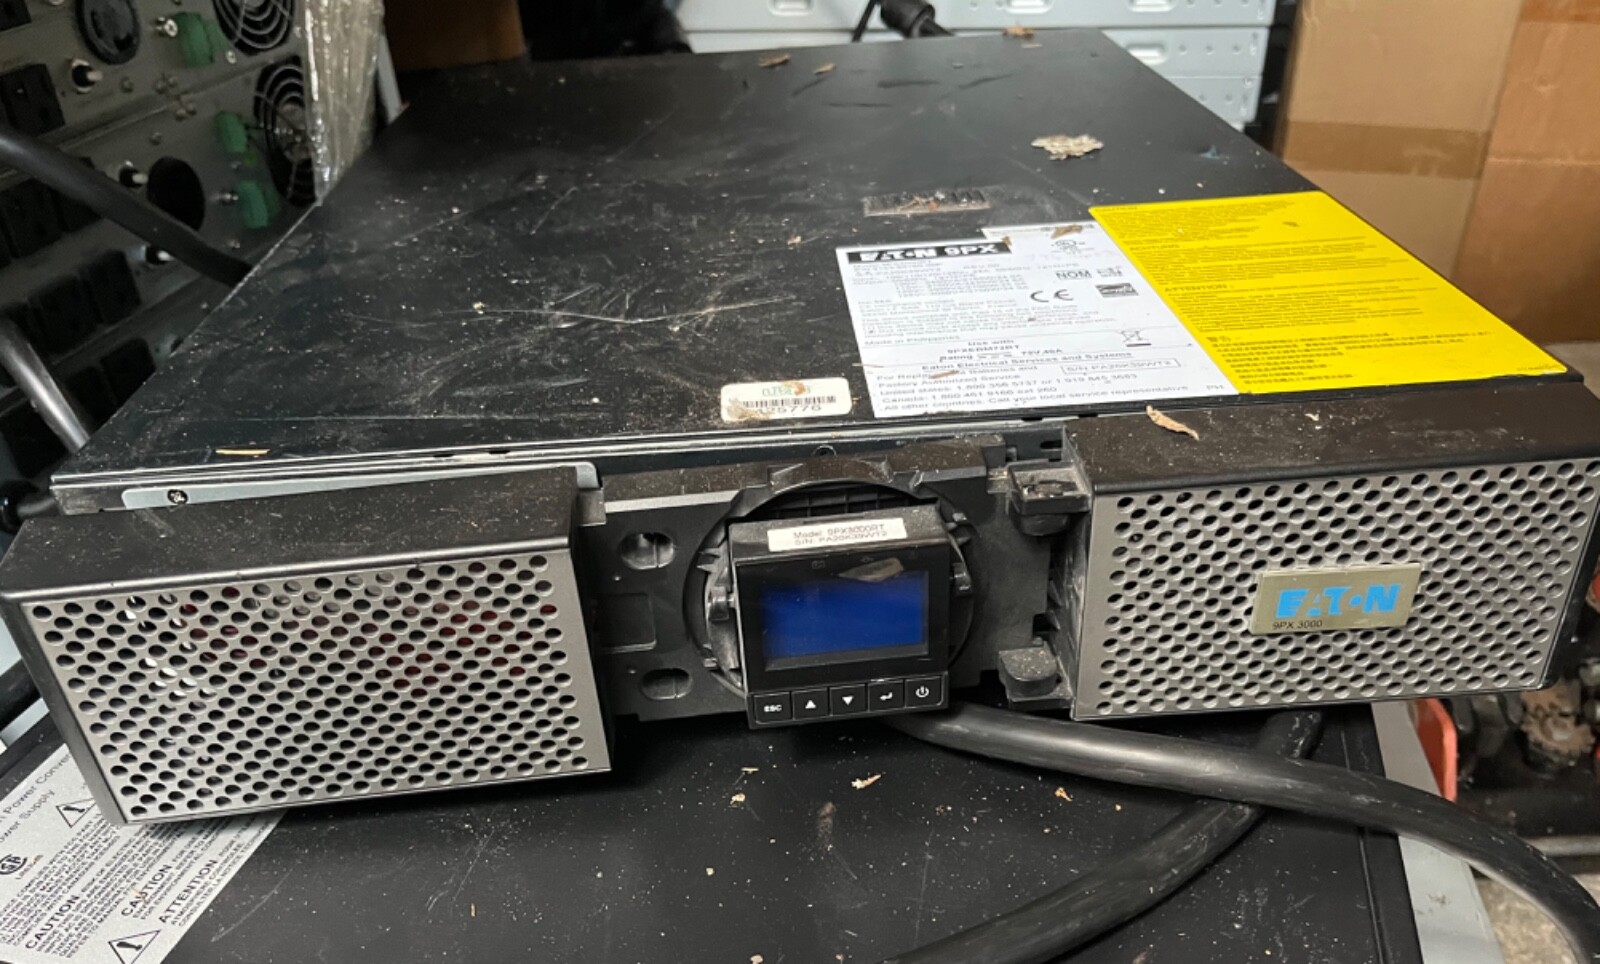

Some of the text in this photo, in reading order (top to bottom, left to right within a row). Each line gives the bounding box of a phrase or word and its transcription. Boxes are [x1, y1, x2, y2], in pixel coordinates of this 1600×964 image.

[860, 244, 997, 262] EATON 9PX
[1275, 583, 1402, 618] EATON
[1272, 619, 1323, 630] 9PX 3000
[3, 786, 37, 814] Power
[19, 790, 55, 819] Supply
[119, 865, 173, 915] CAUTION
[157, 860, 218, 921] ATTENTION
[23, 895, 81, 948] CAUTION
